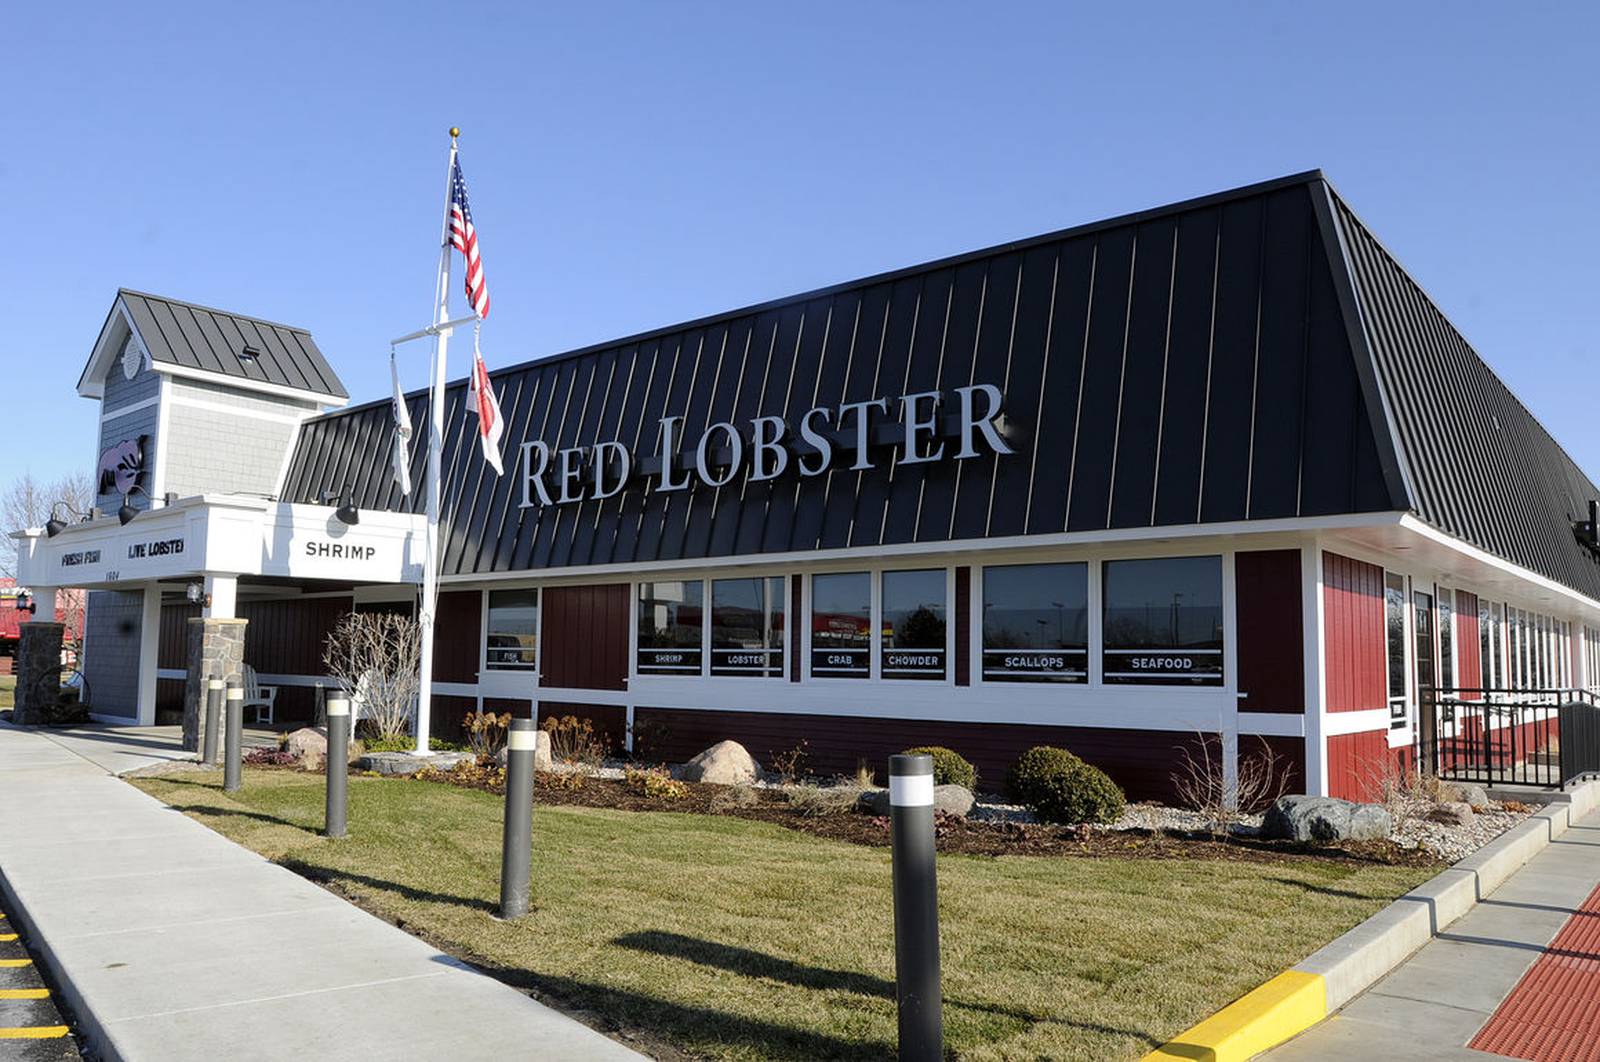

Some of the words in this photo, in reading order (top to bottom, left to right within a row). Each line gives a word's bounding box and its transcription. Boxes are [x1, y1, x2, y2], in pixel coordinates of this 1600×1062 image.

[518, 439, 631, 509] RED
[655, 383, 1015, 493] LOBSTER
[305, 541, 376, 560] SHRIMP
[655, 654, 683, 663] SHRIMP
[727, 655, 766, 665] LOBSTER
[827, 655, 853, 665] CRAB
[888, 655, 939, 666] CHOWDER
[1004, 657, 1064, 668] SCALLOPS
[1131, 658, 1193, 669] SEAFOOD
